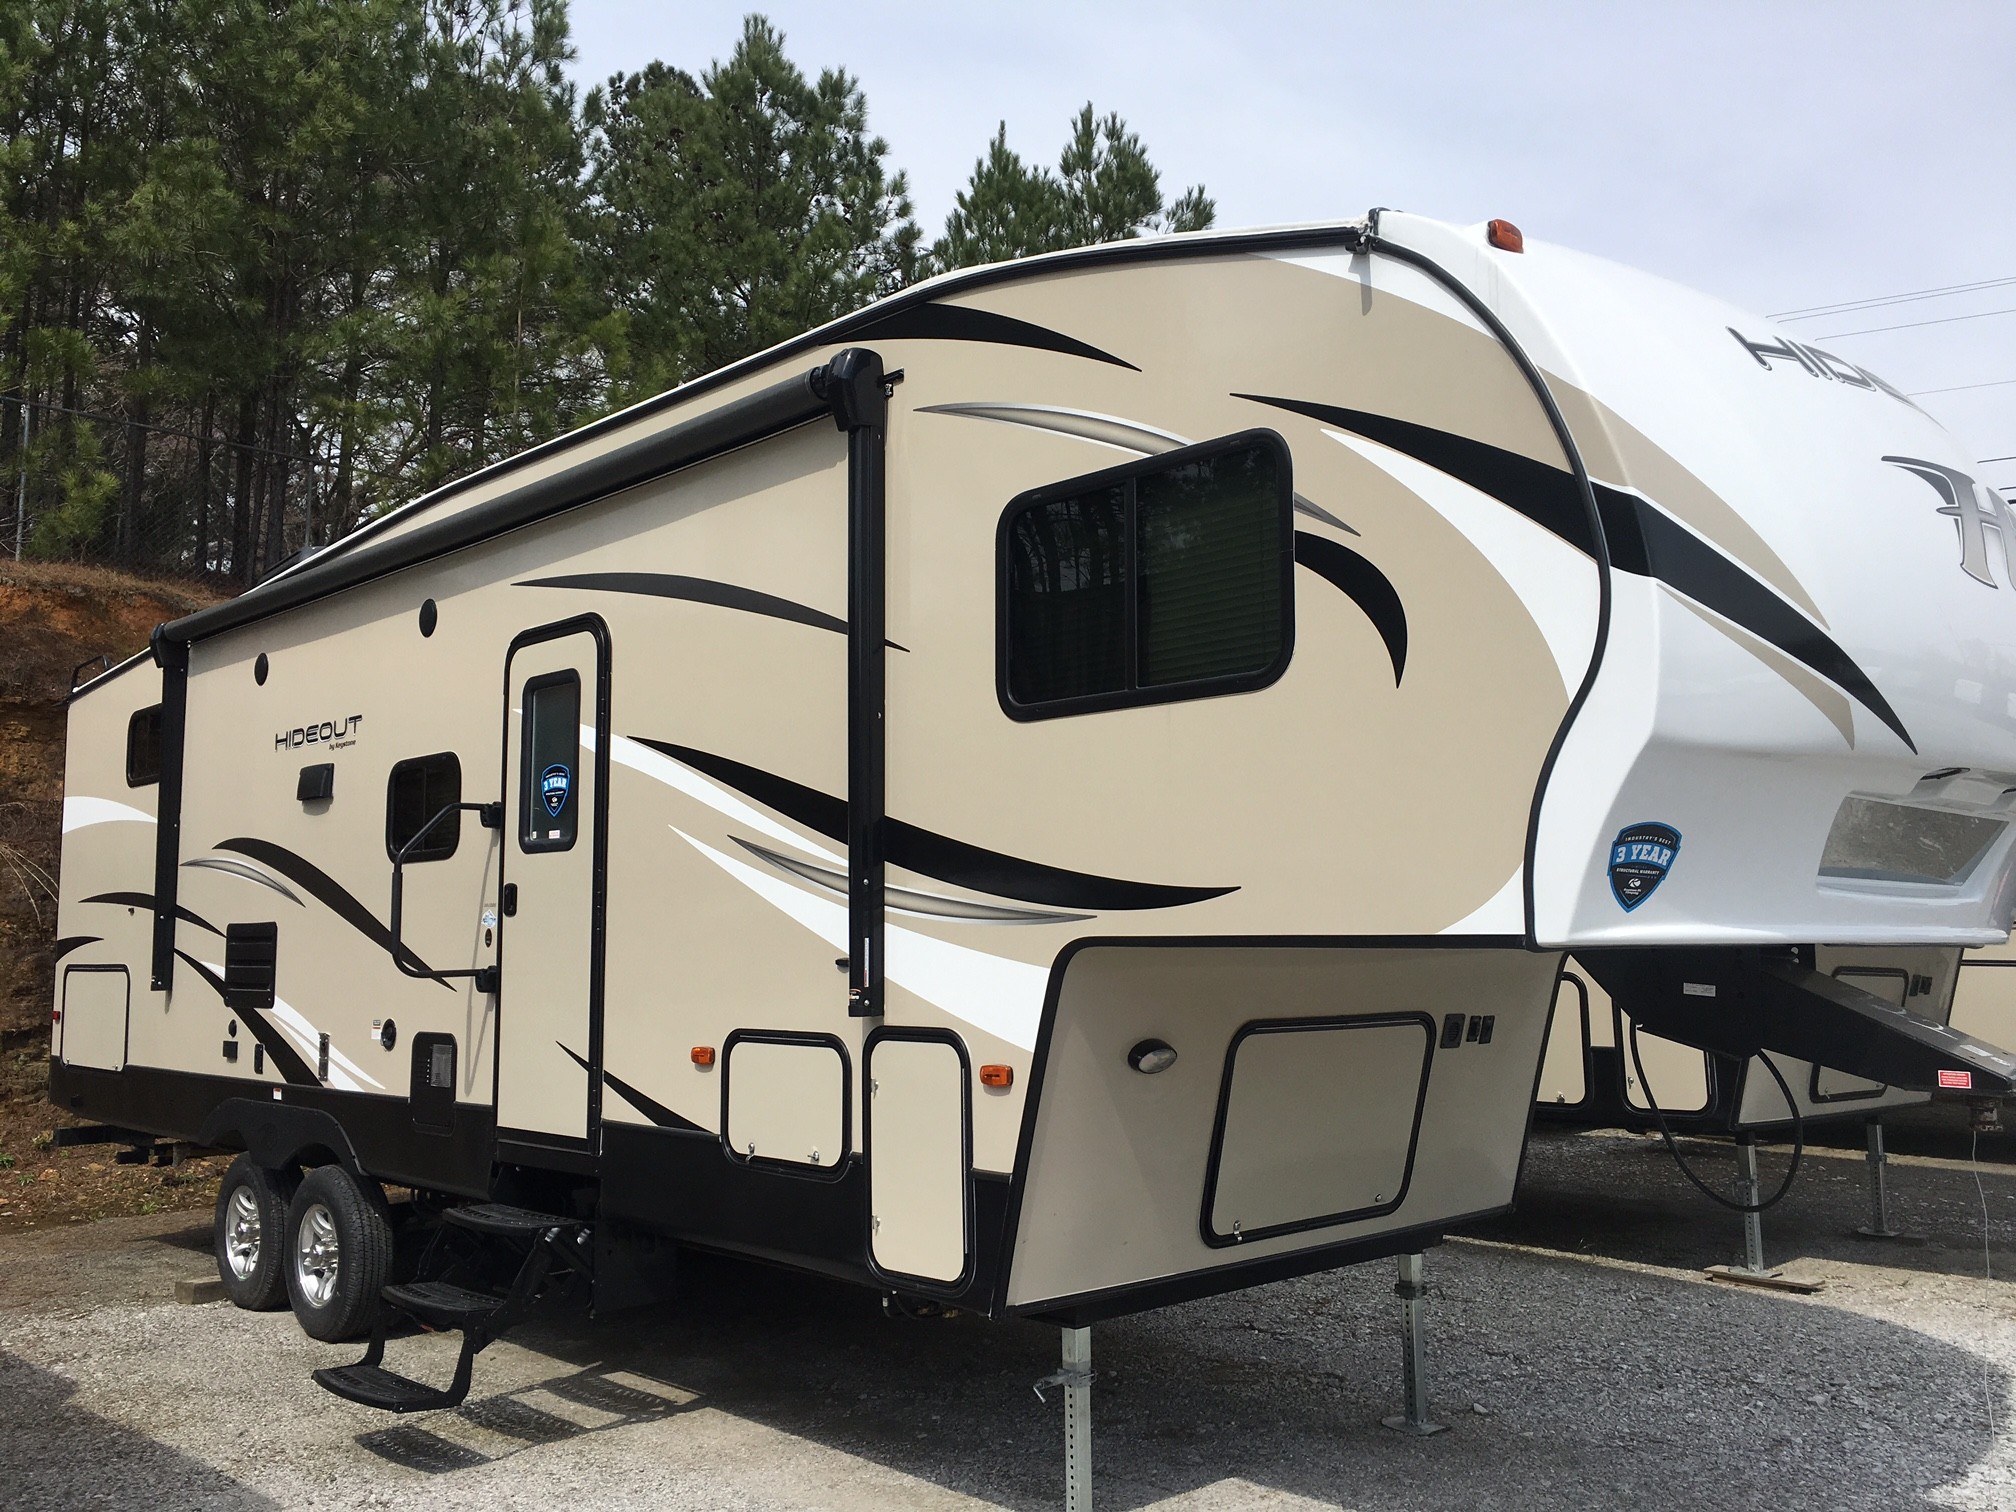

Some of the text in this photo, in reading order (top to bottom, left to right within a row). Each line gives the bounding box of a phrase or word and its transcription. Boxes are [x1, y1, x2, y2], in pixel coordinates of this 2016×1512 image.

[275, 714, 362, 752] HIDEOUT
[543, 777, 567, 791] 3 YEAR
[1616, 844, 1671, 866] 3 YEAR
